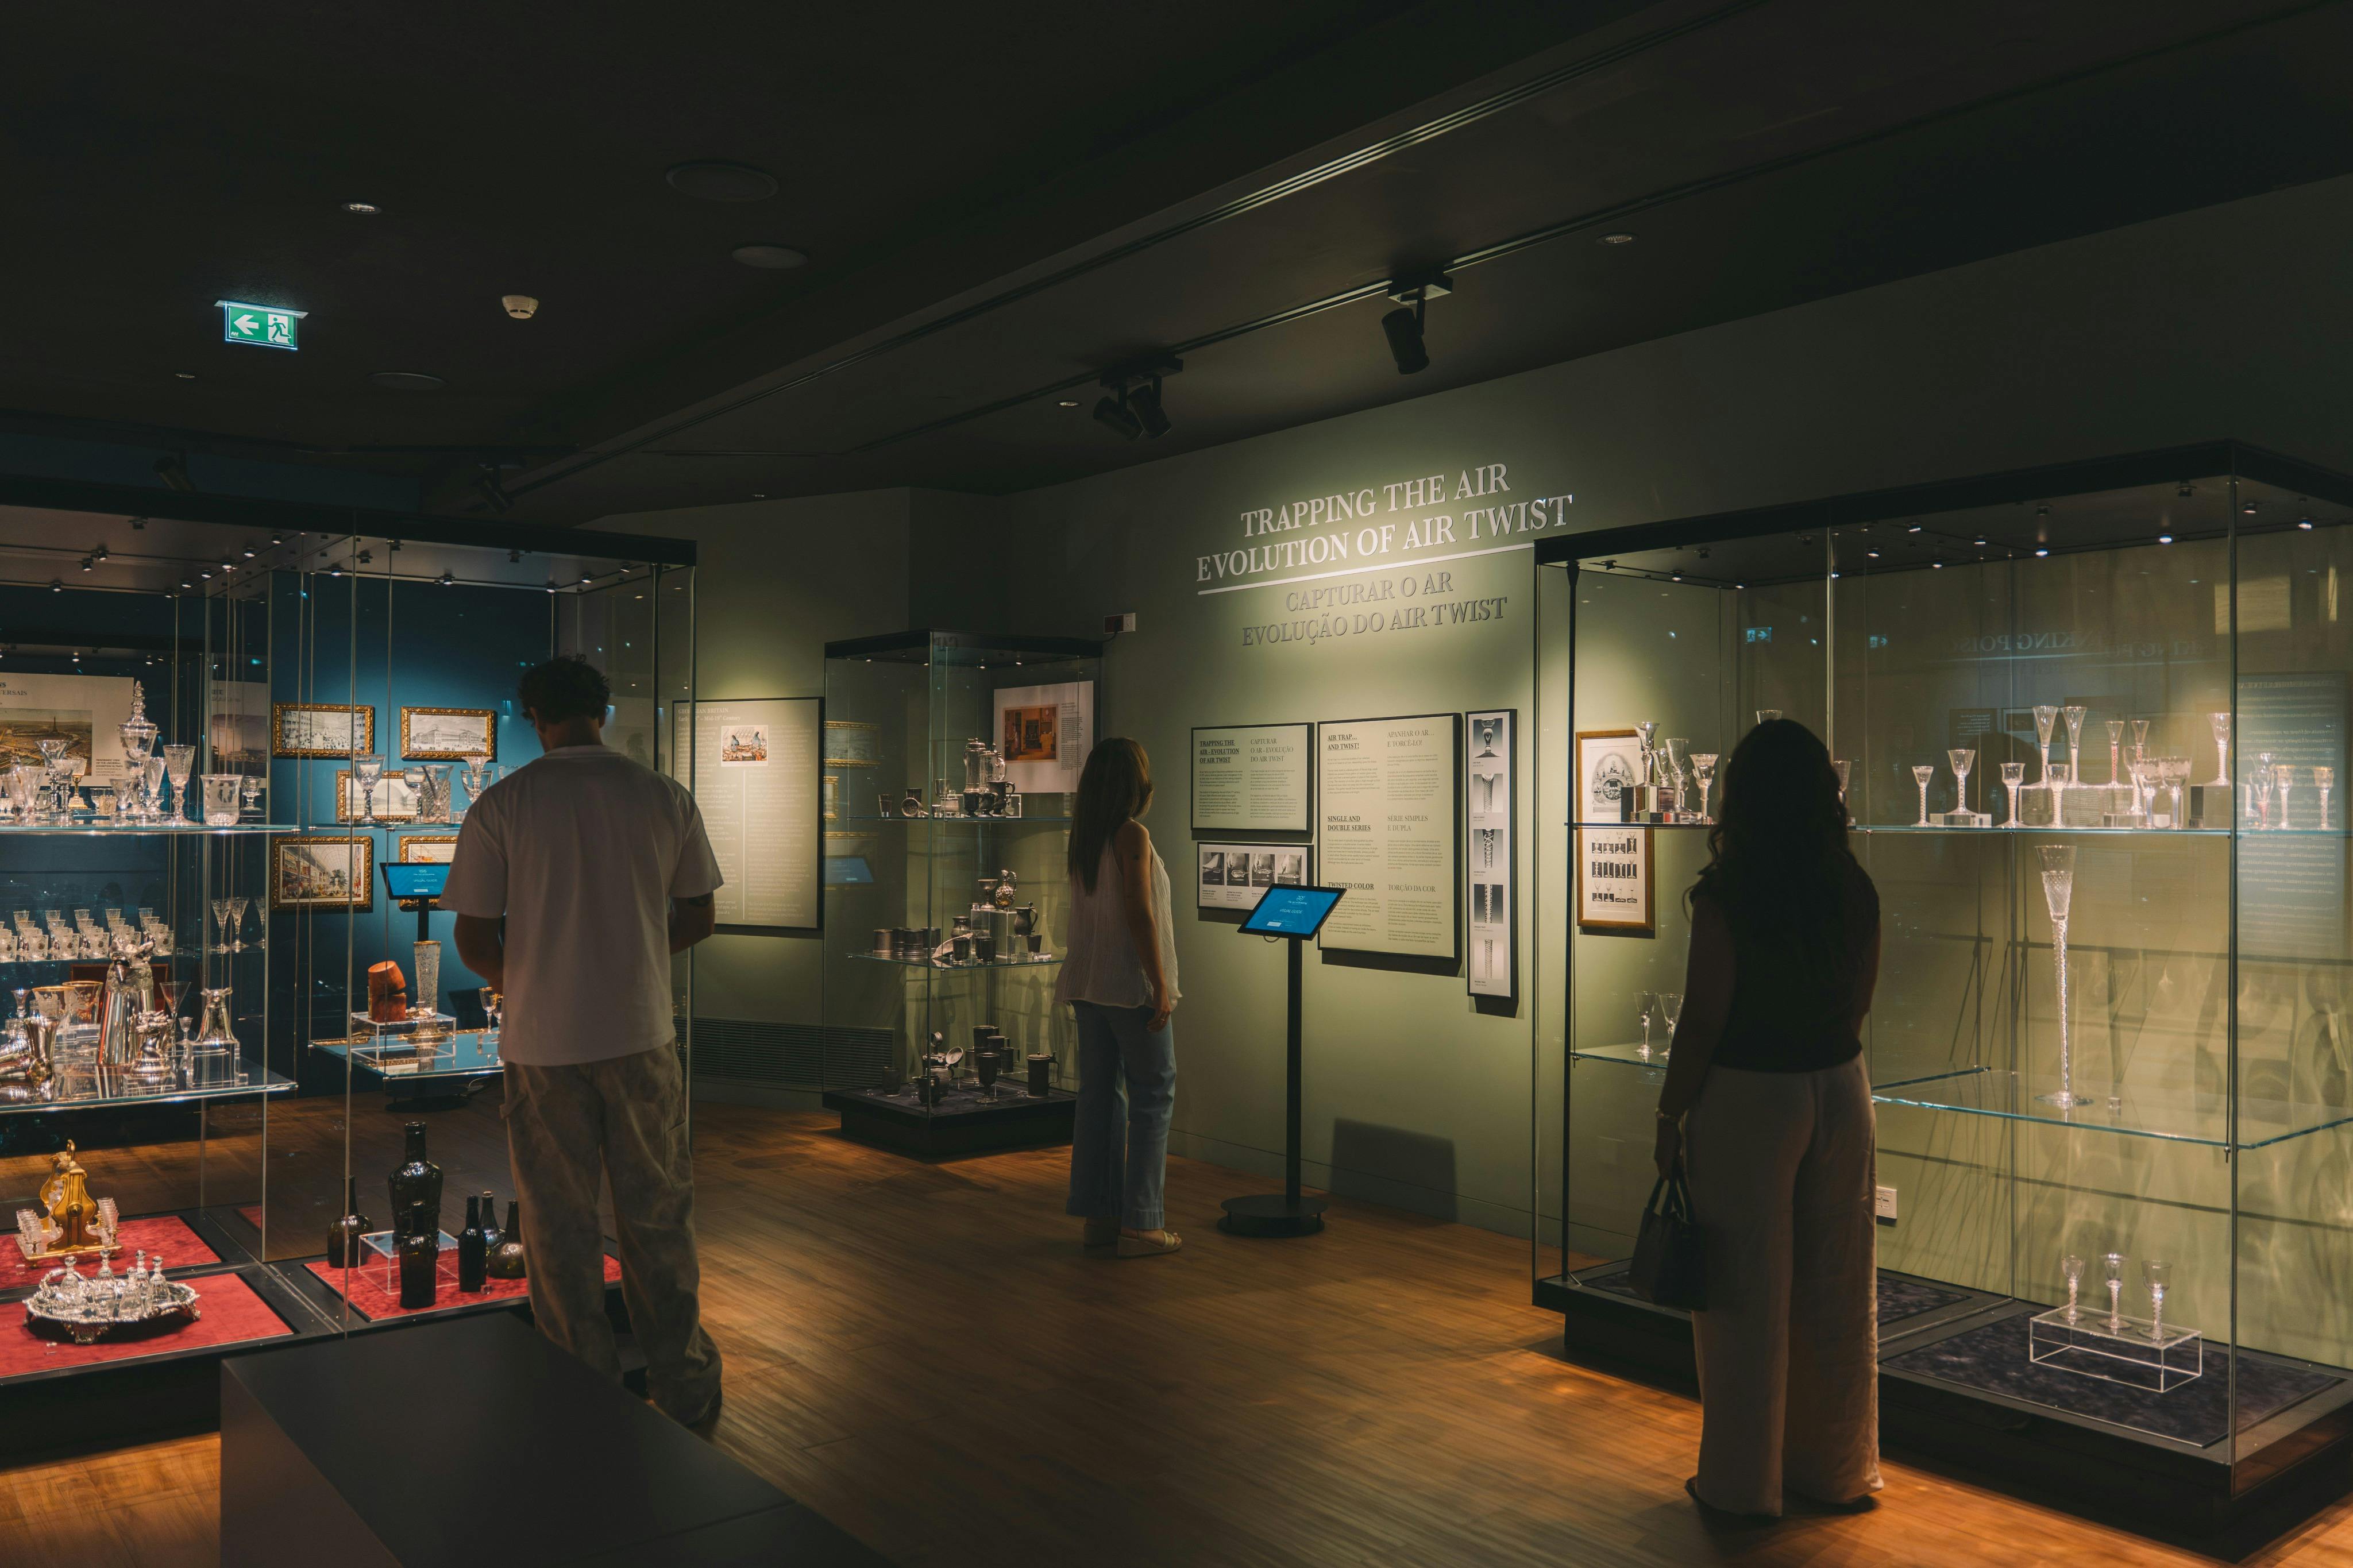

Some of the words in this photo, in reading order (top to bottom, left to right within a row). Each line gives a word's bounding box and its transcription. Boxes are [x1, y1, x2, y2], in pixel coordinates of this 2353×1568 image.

[1241, 488, 1376, 538] TRAPPING
[1383, 474, 1447, 512] THE
[1453, 463, 1511, 500] AIR
[1196, 532, 1350, 581] EVOLUTION
[1357, 524, 1397, 557] OF
[1402, 515, 1457, 550] AIR
[1463, 493, 1573, 540] TWIST
[1286, 579, 1395, 611] CAPTURAR
[1399, 576, 1417, 597] O
[1421, 571, 1453, 594] AR
[1242, 612, 1348, 646] EVOLUÇÃO
[1353, 609, 1384, 634] DO
[1388, 605, 1428, 631] AIR
[1430, 596, 1507, 626] TWIST
[1266, 746, 1294, 754] EVOLUÇÃO
[1387, 814, 1403, 822] SÉRIE
[1388, 884, 1413, 892] TORÇÃO
